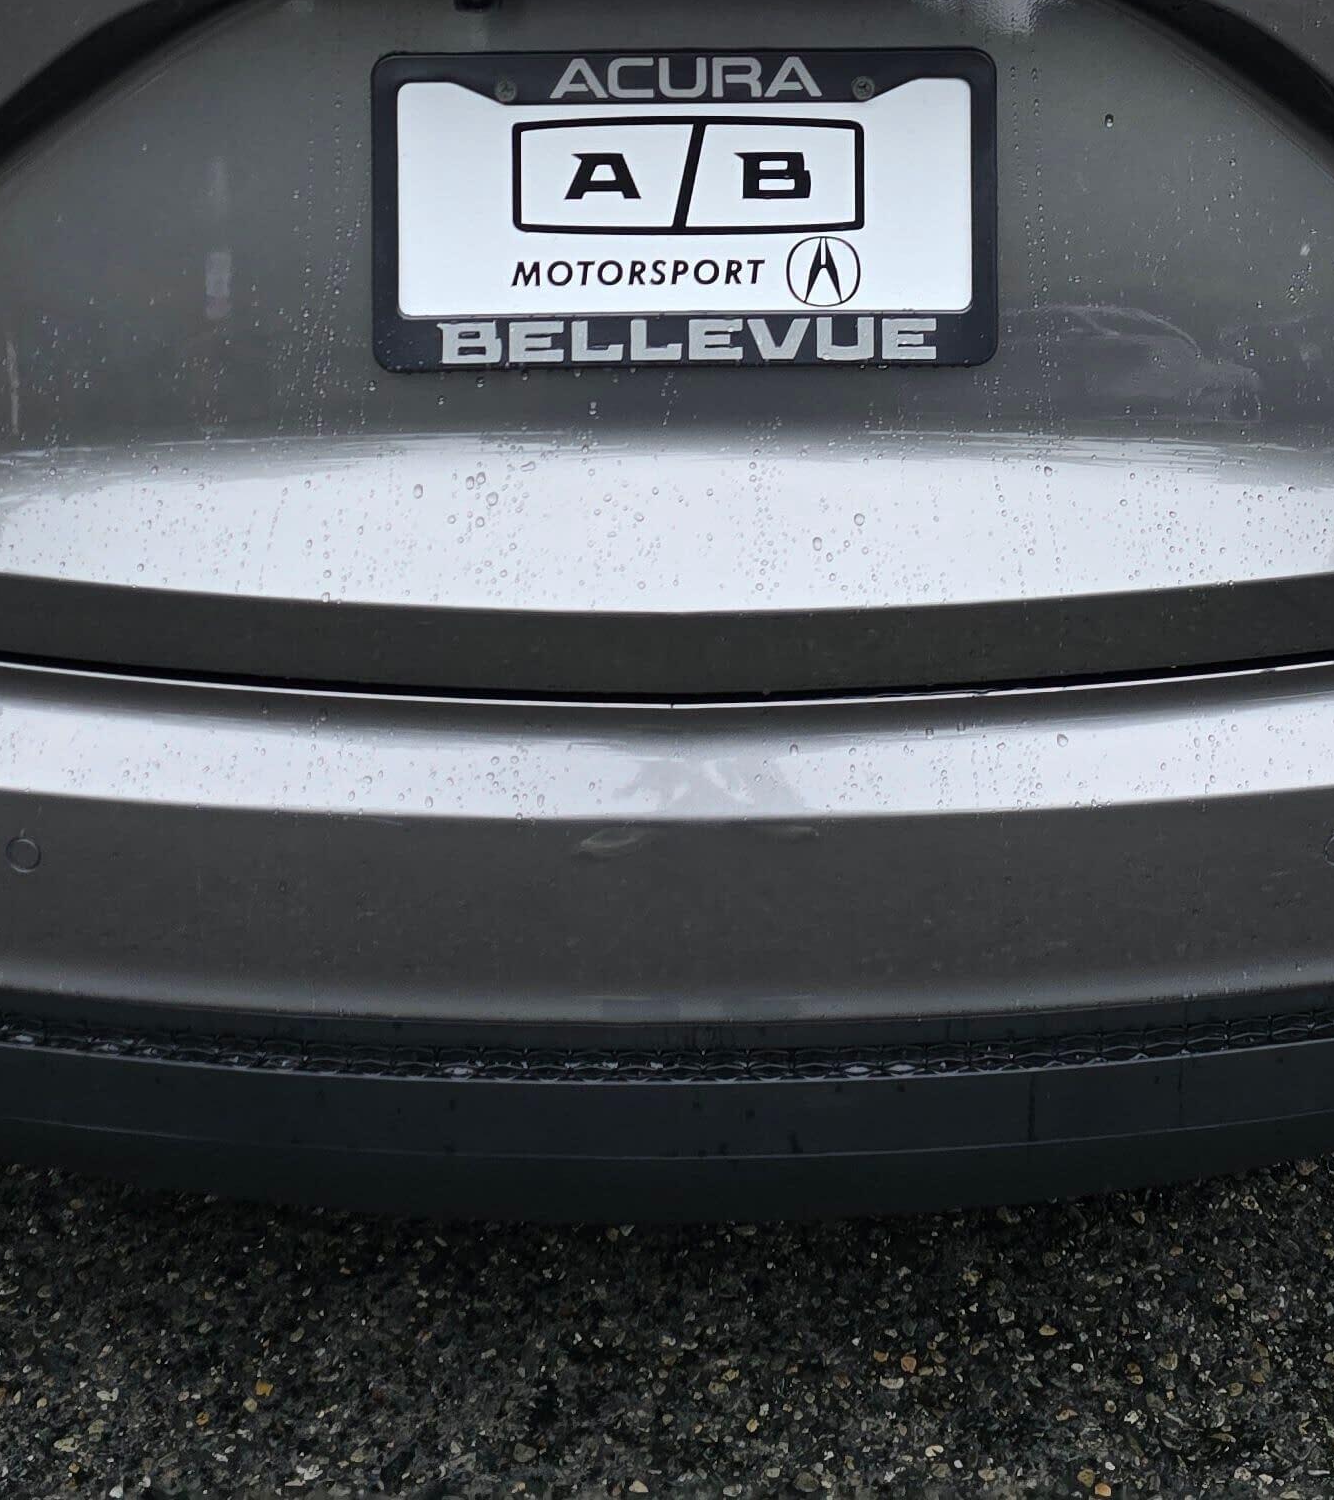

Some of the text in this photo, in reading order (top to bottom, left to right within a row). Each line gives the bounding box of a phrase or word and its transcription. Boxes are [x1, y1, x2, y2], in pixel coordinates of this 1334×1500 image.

[549, 56, 822, 99] ACURA
[511, 258, 766, 287] MOTORSPORT
[436, 316, 938, 365] BELLEVUE
